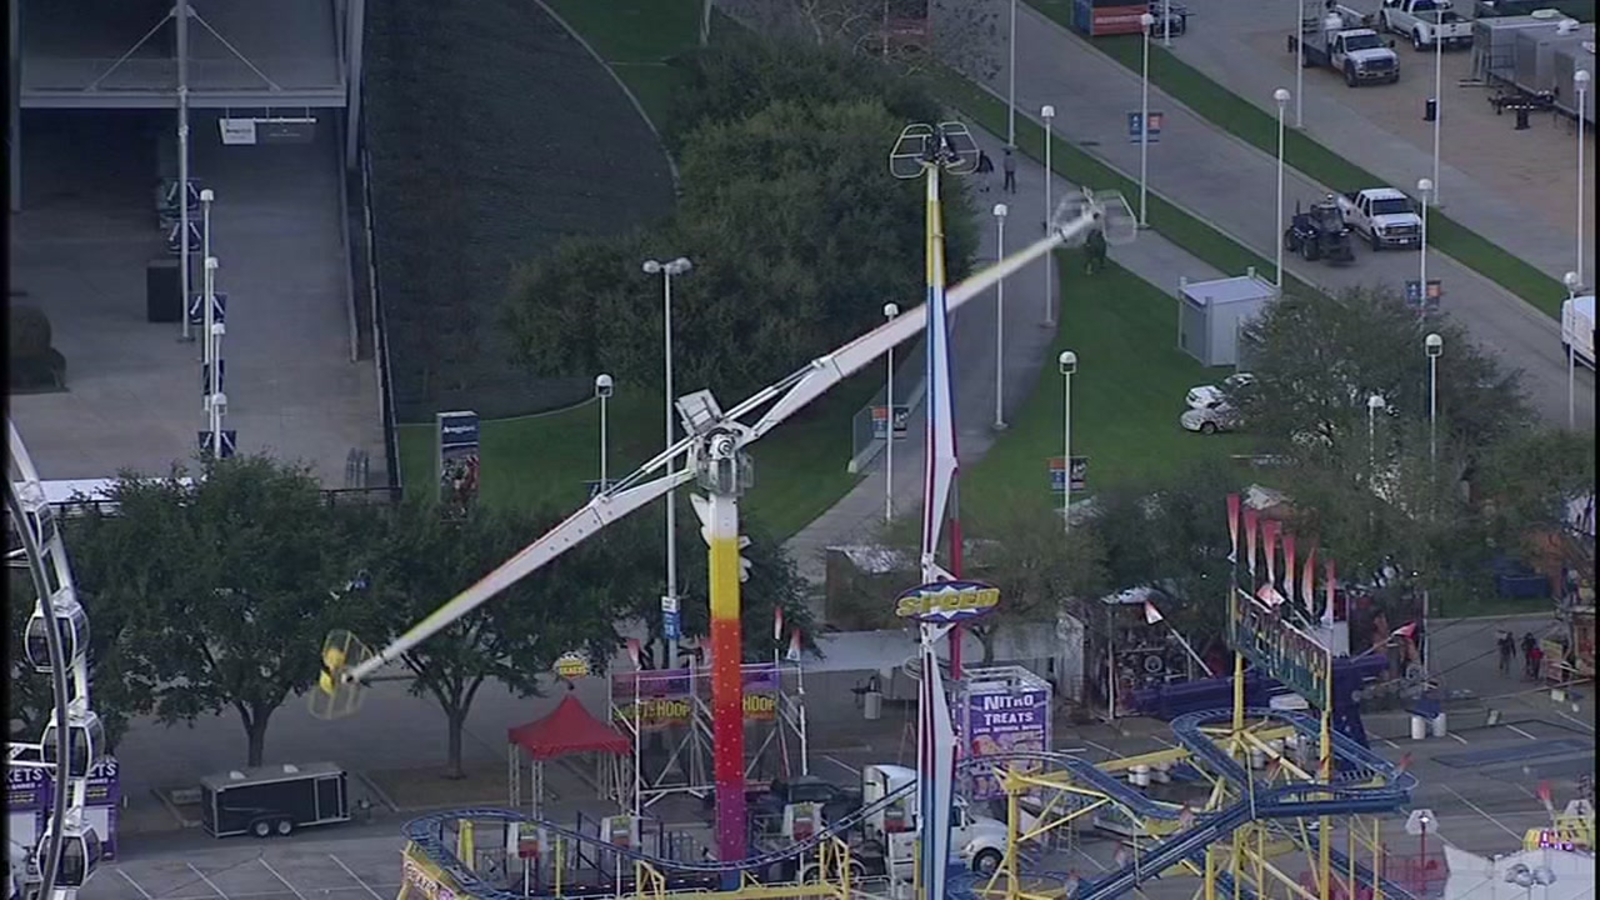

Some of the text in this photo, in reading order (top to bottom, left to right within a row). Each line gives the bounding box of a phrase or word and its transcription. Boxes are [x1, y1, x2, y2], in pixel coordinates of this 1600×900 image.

[895, 588, 1000, 616] SPEED
[984, 694, 1034, 711] NITRO
[984, 711, 1034, 726] TREATS
